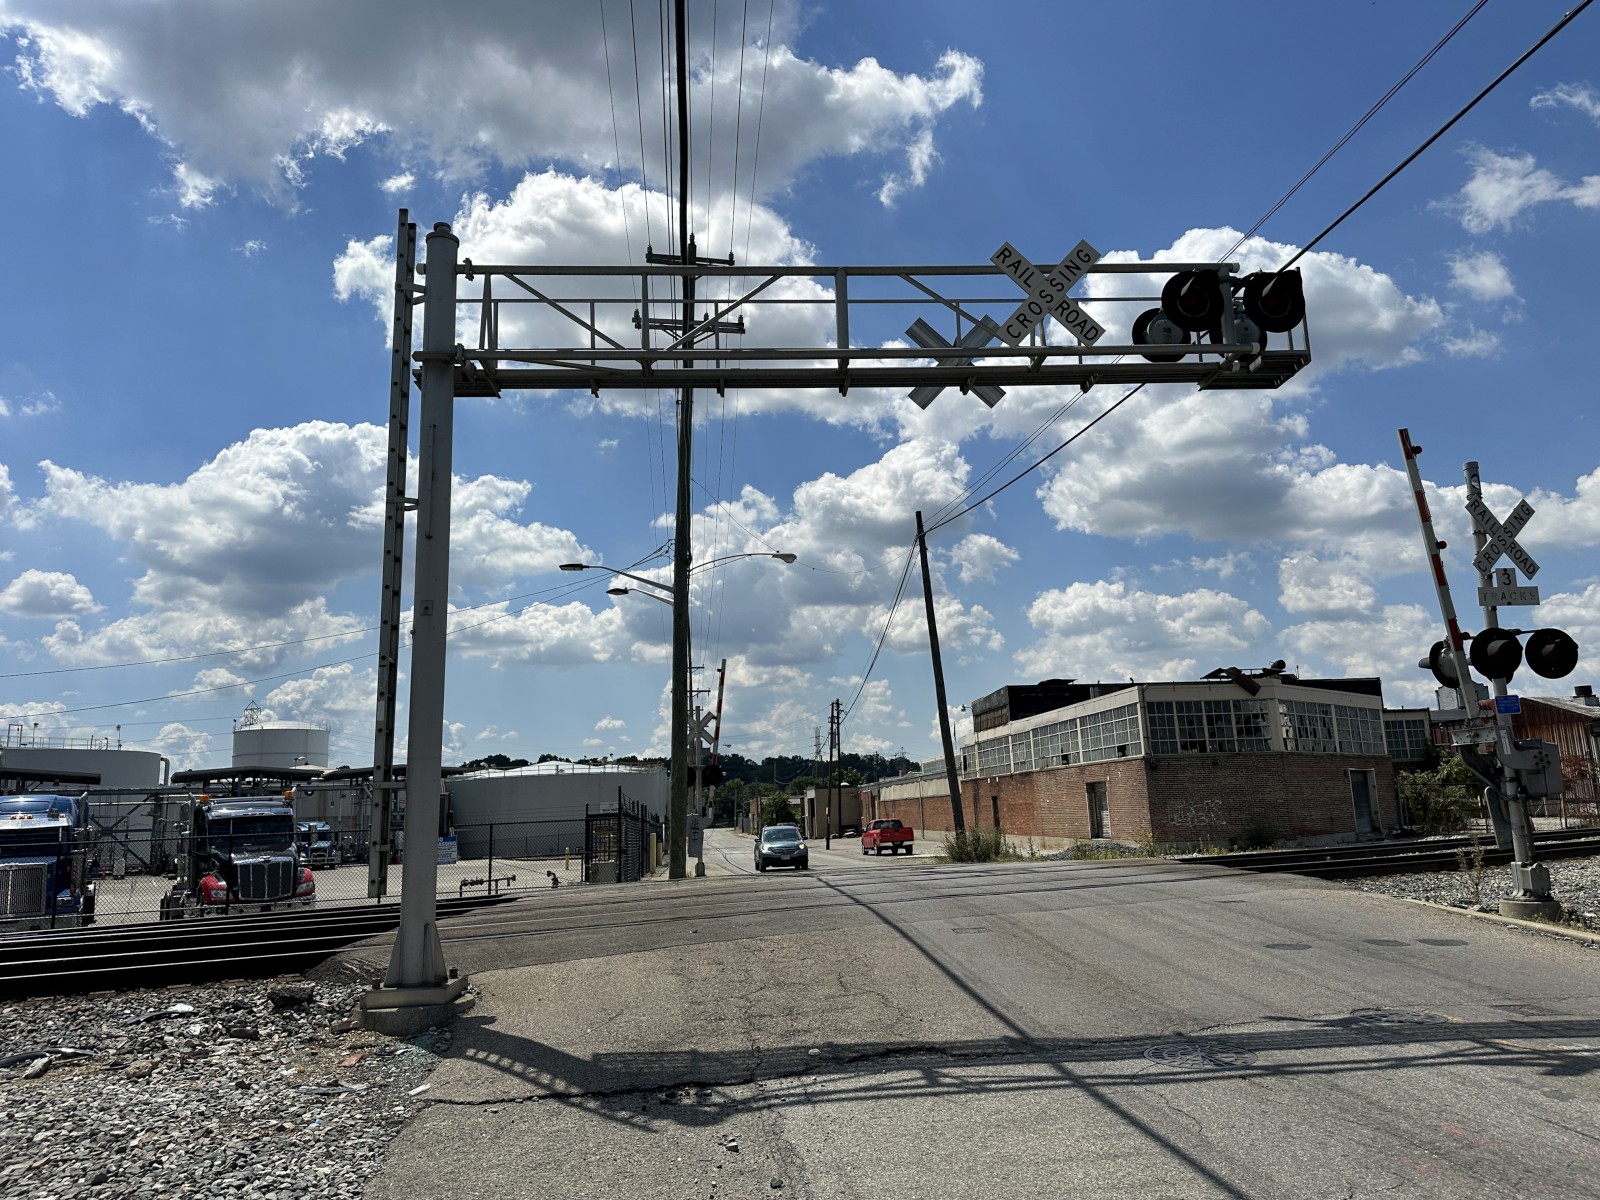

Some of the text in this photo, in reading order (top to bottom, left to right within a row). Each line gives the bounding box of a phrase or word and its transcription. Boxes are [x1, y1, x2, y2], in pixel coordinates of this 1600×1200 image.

[996, 247, 1098, 341] RAIL ROAD
[1006, 249, 1092, 339] CROSSING
[1470, 500, 1536, 576] RAIL ROAD
[1477, 503, 1531, 573] CROSSING
[1482, 591, 1537, 601] TRACKS
[1502, 572, 1511, 585] 3
